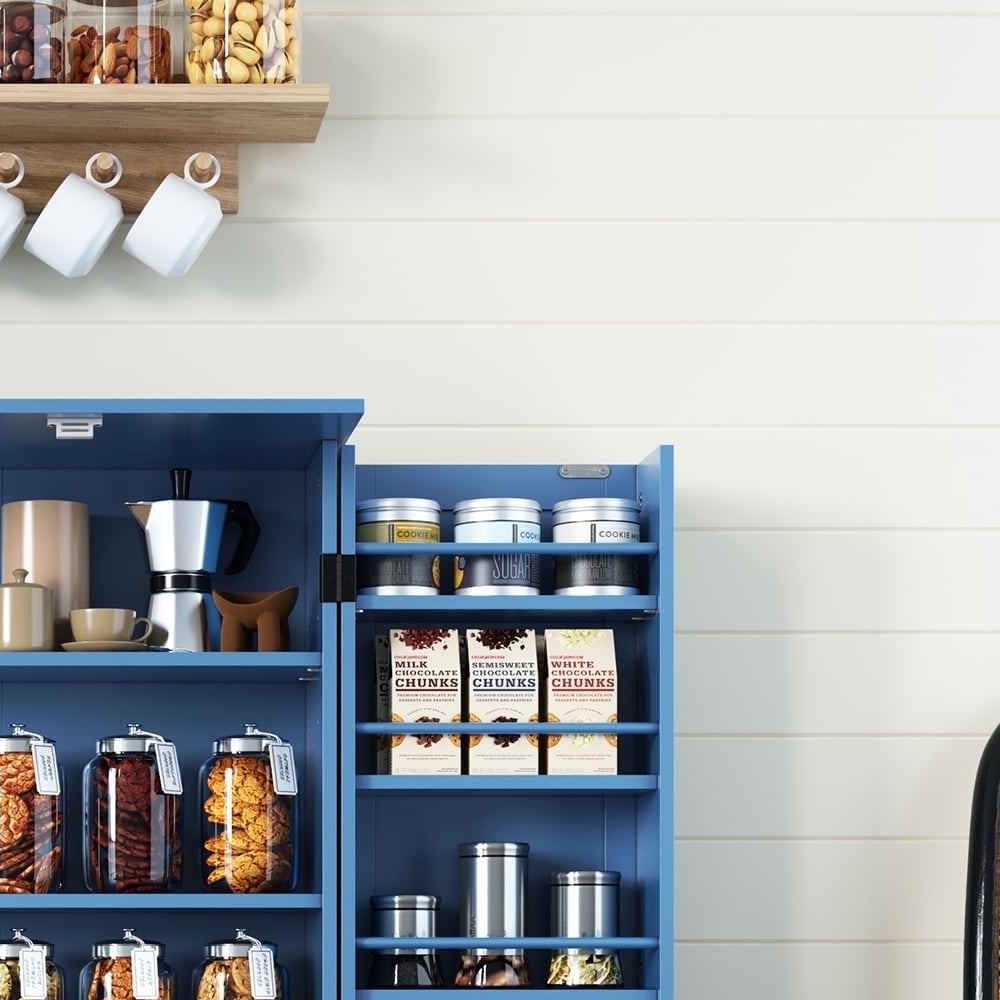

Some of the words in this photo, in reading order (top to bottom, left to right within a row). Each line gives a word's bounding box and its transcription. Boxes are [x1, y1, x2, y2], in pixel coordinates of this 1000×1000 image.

[396, 530, 429, 539] COOKIE
[598, 530, 630, 539] COOKIE
[492, 553, 531, 580] SUGAR
[394, 661, 428, 669] MILK
[551, 661, 595, 669] WHITE
[395, 678, 459, 688] CHUNKS
[472, 678, 536, 688] CHUNKS
[551, 678, 615, 688] CHUNKS
